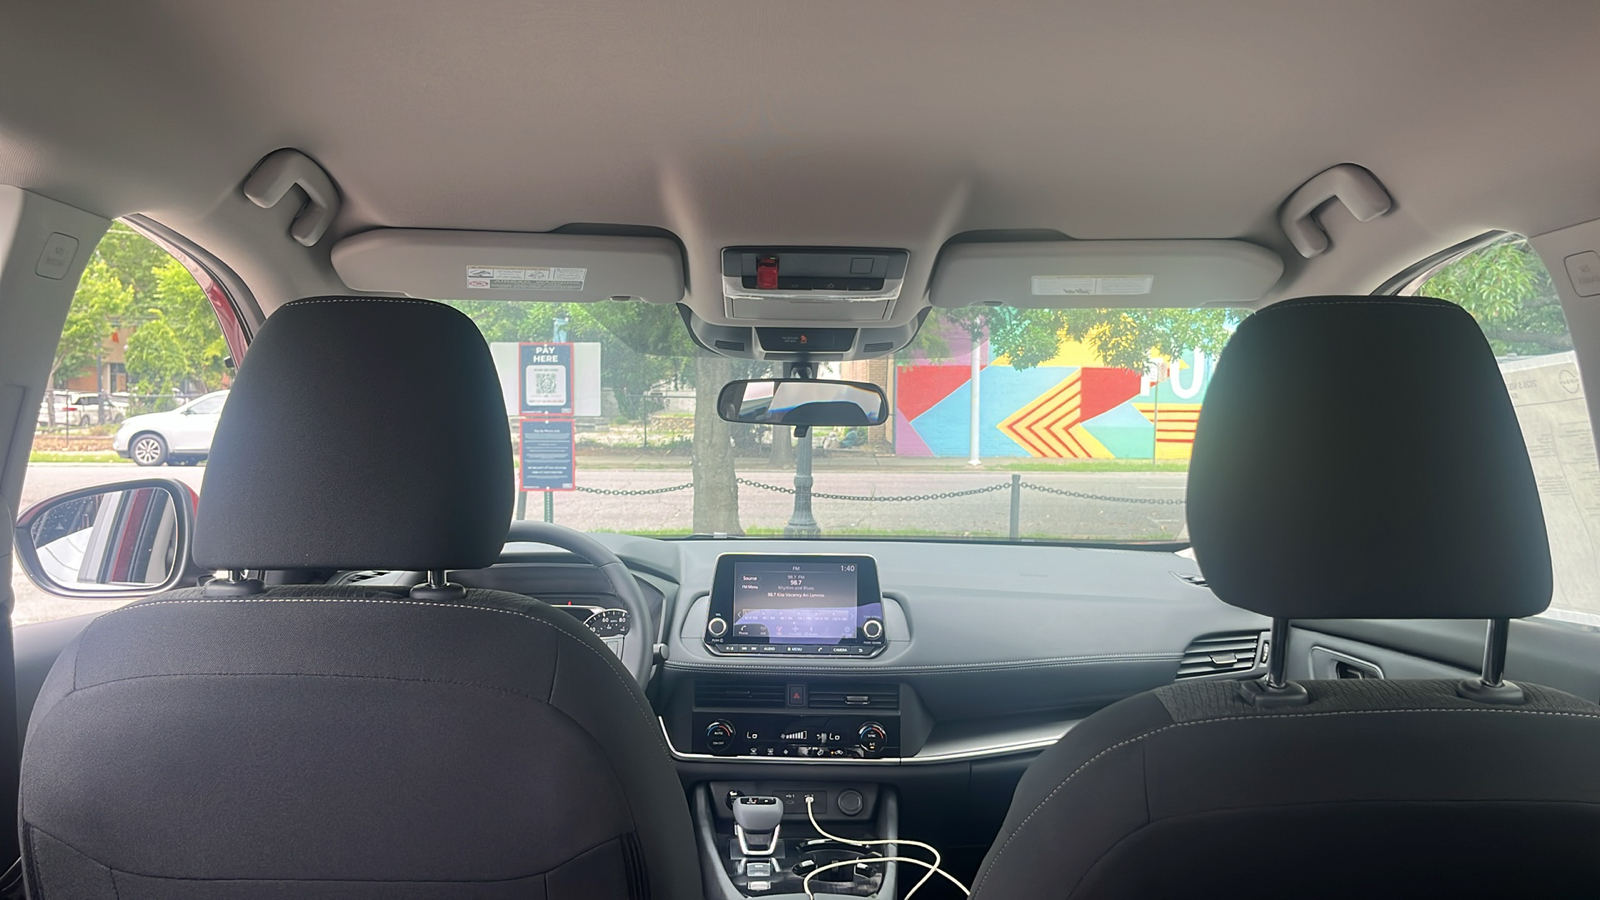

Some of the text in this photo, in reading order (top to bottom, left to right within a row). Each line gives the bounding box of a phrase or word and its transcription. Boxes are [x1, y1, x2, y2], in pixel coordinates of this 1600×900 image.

[536, 346, 555, 354] PAY
[533, 355, 559, 363] HERE
[746, 731, 758, 739] Lo
[829, 732, 840, 741] Lo
